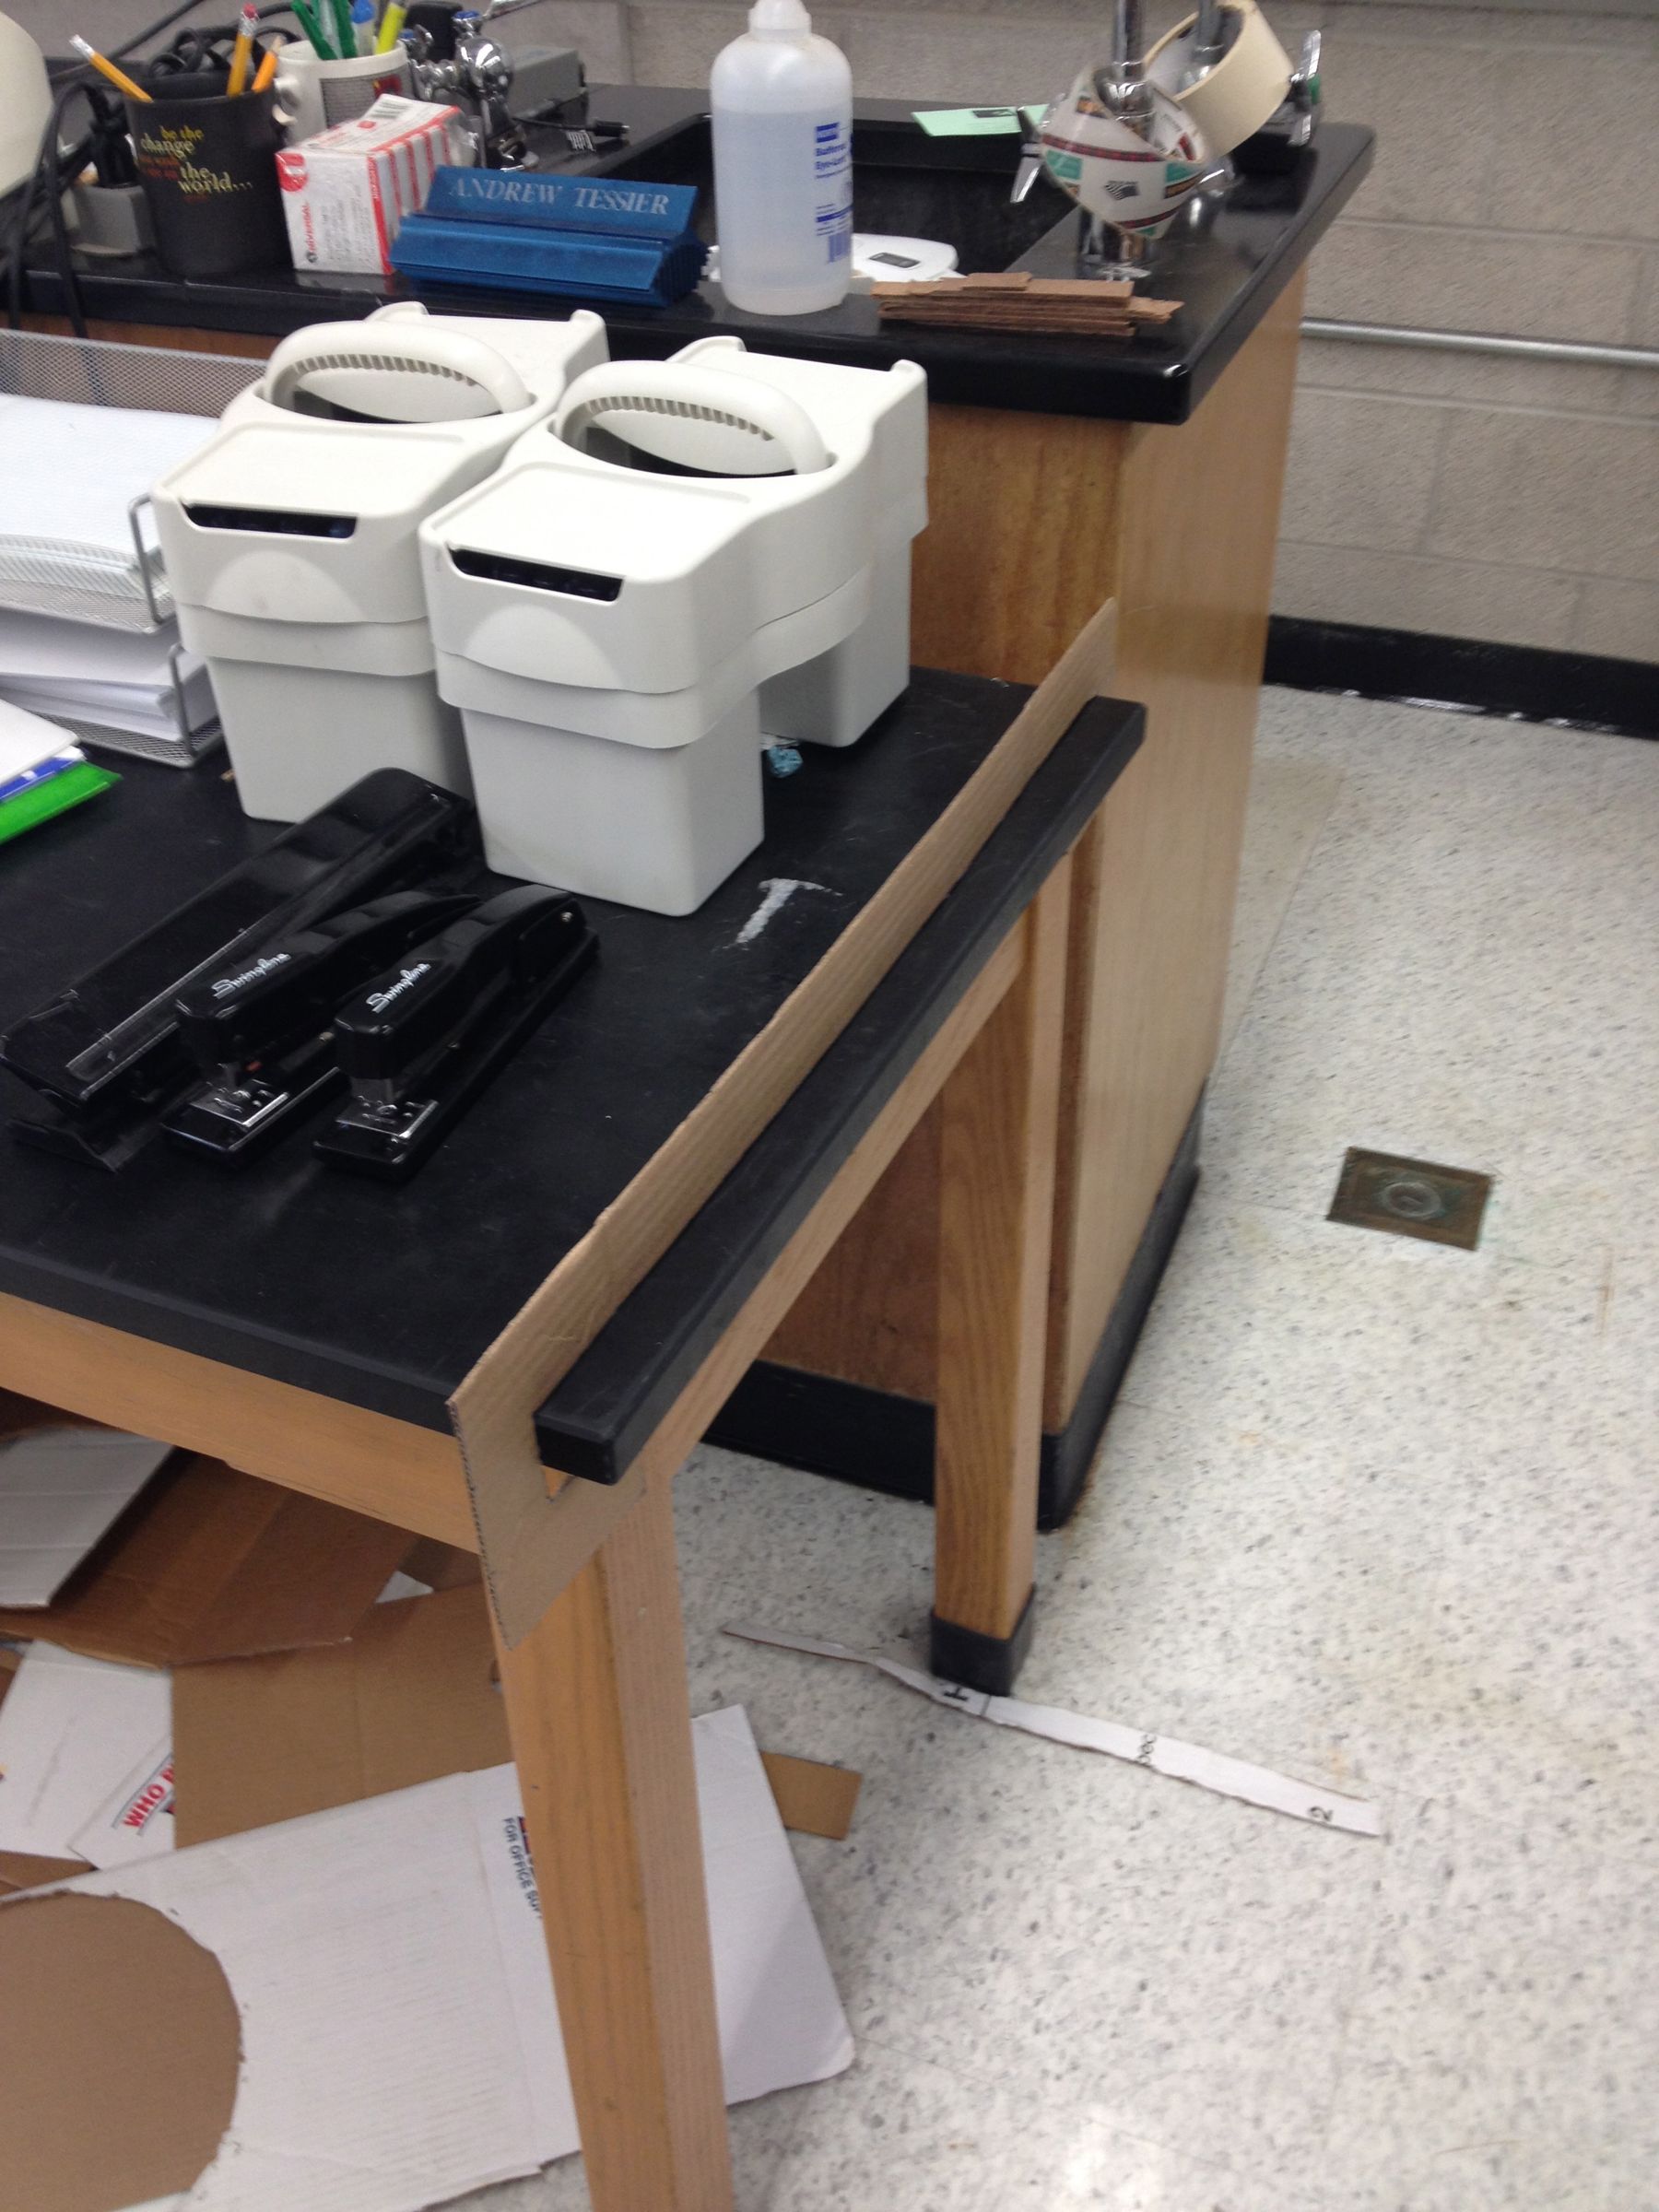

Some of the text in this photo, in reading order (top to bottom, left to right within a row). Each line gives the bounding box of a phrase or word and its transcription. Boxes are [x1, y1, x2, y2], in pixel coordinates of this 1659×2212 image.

[140, 133, 195, 161] change
[159, 124, 204, 141] be the
[179, 161, 211, 181] the
[450, 177, 669, 216] ANDREW TESSIER
[210, 952, 292, 1000] Swingline
[366, 963, 431, 1014] Swingline
[121, 1783, 166, 1829] WHO
[502, 1817, 519, 1843] FOR
[510, 1845, 534, 1890] OFFICE
